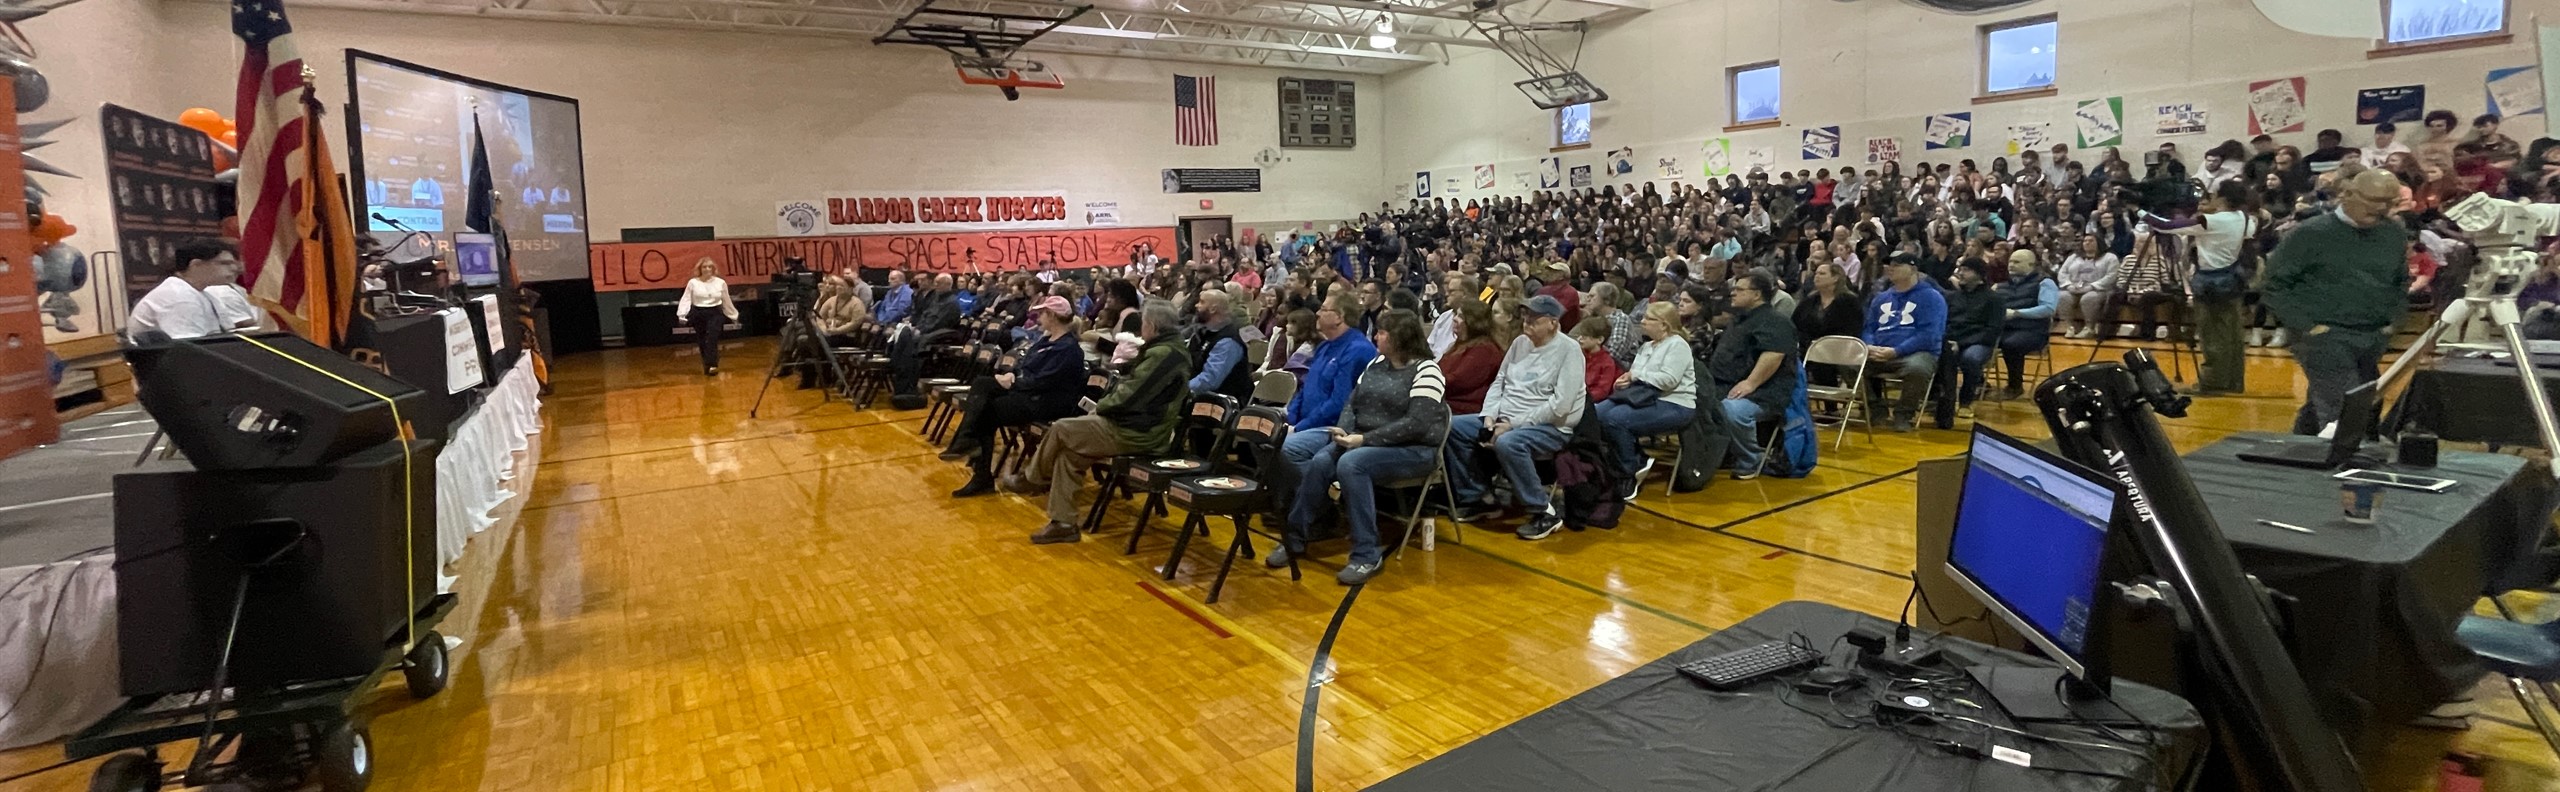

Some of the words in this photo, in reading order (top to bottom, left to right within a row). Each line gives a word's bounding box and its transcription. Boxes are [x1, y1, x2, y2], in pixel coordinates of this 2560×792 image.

[397, 215, 440, 226] CONTROL
[778, 202, 821, 218] WELCOME
[827, 197, 916, 225] HARBOR
[917, 196, 983, 223] CREEK
[985, 195, 1066, 222] HUSKIES
[508, 238, 561, 251] ENSEN
[600, 248, 669, 286] LLO
[721, 237, 863, 277] INTERNATIONAL
[887, 236, 957, 270] SPACE
[985, 234, 1098, 265] STATION
[2115, 470, 2153, 523] APERTURA
